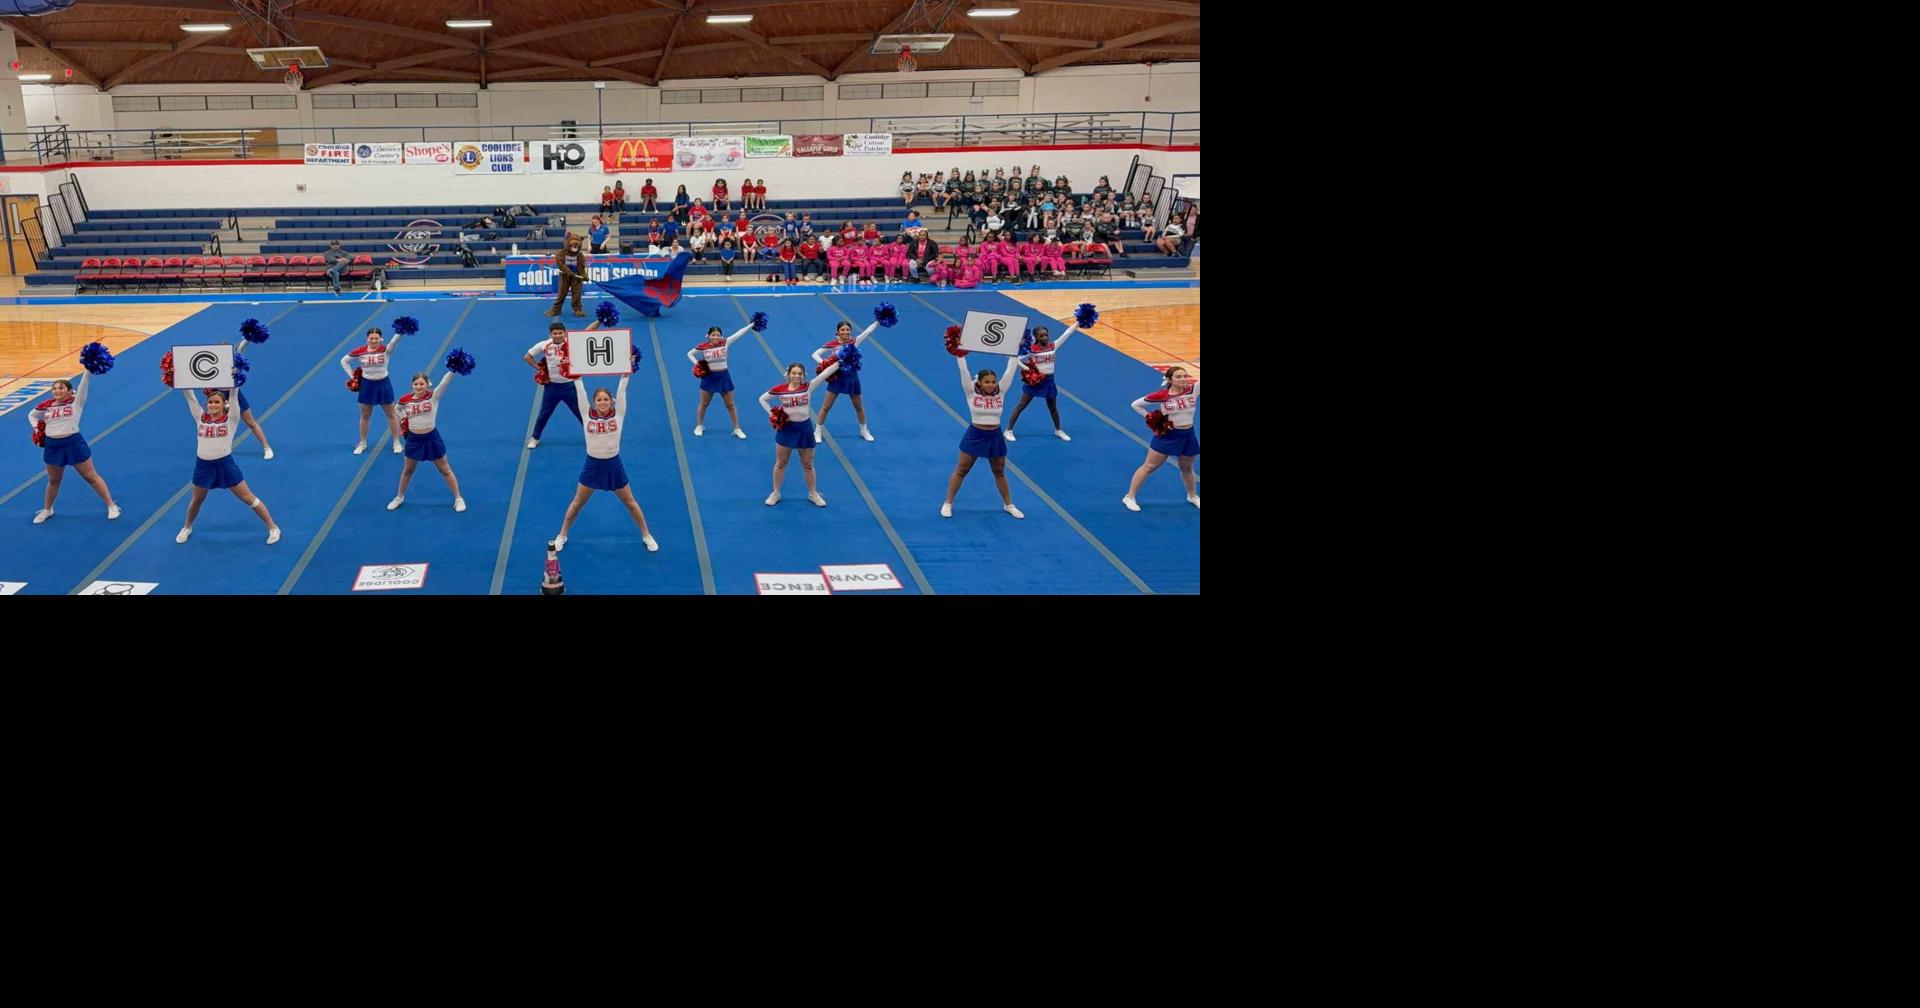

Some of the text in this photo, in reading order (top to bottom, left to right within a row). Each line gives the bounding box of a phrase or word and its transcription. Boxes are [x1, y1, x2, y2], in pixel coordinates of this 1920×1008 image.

[406, 144, 450, 157] Shope's
[481, 143, 522, 152] COOLIDGE
[490, 154, 514, 163] LIONS
[491, 163, 513, 172] CLUB
[981, 318, 1007, 346] S
[586, 336, 614, 367] H
[189, 350, 220, 381] C
[780, 394, 809, 407] CHS
[974, 395, 1003, 409] CHS
[1164, 397, 1195, 411] CHS
[198, 425, 228, 438] CHS
[587, 420, 618, 434] CHS
[829, 573, 893, 582] DOWN
[760, 583, 825, 591] FENCE
